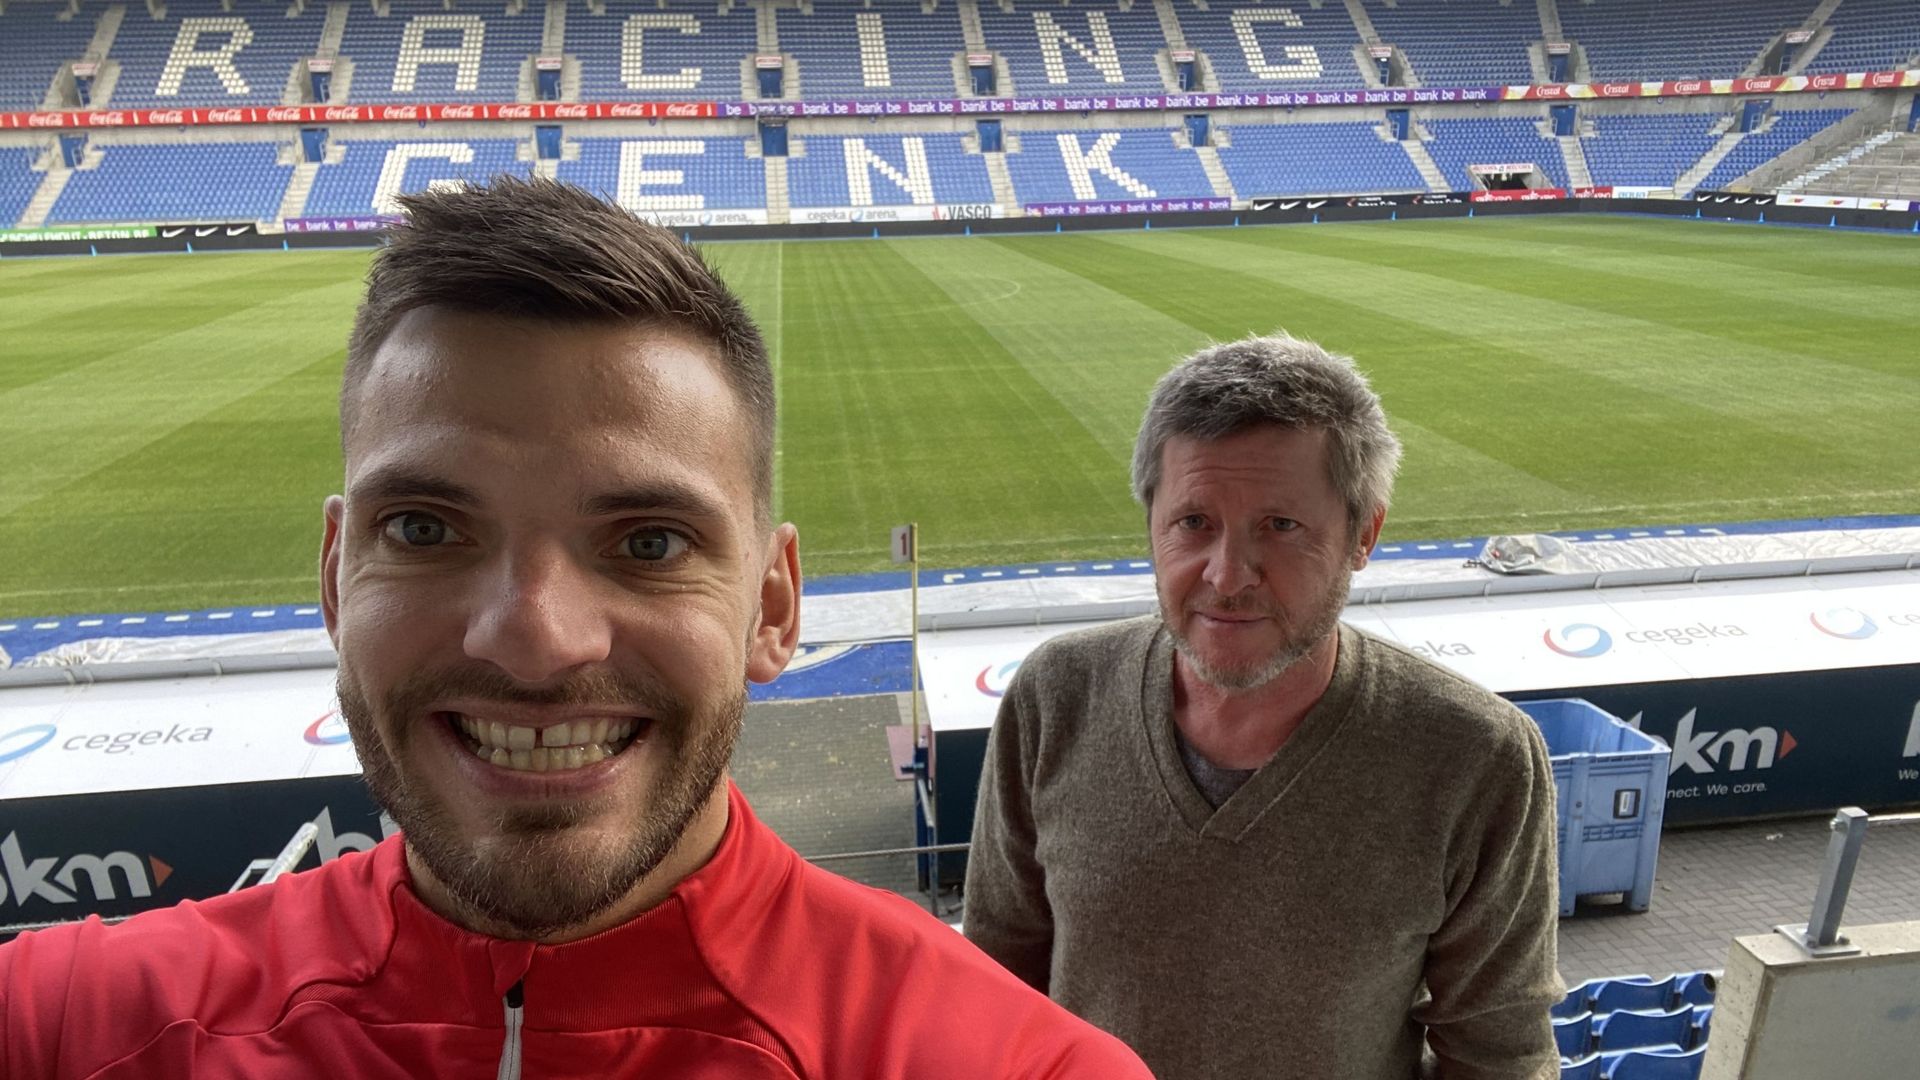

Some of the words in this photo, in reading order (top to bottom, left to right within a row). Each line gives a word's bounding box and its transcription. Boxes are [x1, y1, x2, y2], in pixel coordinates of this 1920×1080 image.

[155, 8, 1323, 96] RACING
[726, 103, 742, 115] be
[802, 102, 830, 114] bank
[833, 102, 848, 114] be
[856, 102, 883, 114] bank
[887, 101, 901, 113] be
[908, 101, 935, 113] bank
[939, 101, 953, 112] be
[961, 100, 988, 112] bank
[991, 100, 1005, 112] be
[1013, 99, 1039, 111] bank
[1042, 99, 1056, 111] be
[1064, 98, 1090, 110] bank
[1093, 98, 1108, 109] be
[1115, 97, 1141, 109] bank
[1144, 97, 1158, 108] be
[1166, 96, 1192, 107] bank
[1195, 95, 1209, 106] be
[1216, 95, 1242, 106] bank
[1245, 94, 1259, 105] be
[1266, 94, 1292, 105] bank
[1295, 93, 1308, 104] be
[1316, 93, 1341, 104] bank
[1344, 92, 1358, 103] be
[1365, 92, 1390, 103] bank
[1393, 90, 1407, 101] be
[1414, 90, 1439, 101] bank
[1441, 88, 1455, 100] be
[1462, 88, 1487, 99] bank
[948, 205, 992, 220] VASCO
[900, 532, 907, 556] 1
[1625, 622, 1748, 645] cegeka
[62, 723, 213, 754] cegeka
[1628, 706, 1778, 777] km
[1706, 784, 1728, 796] We
[1733, 782, 1767, 795] care.
[0, 830, 152, 908] km
